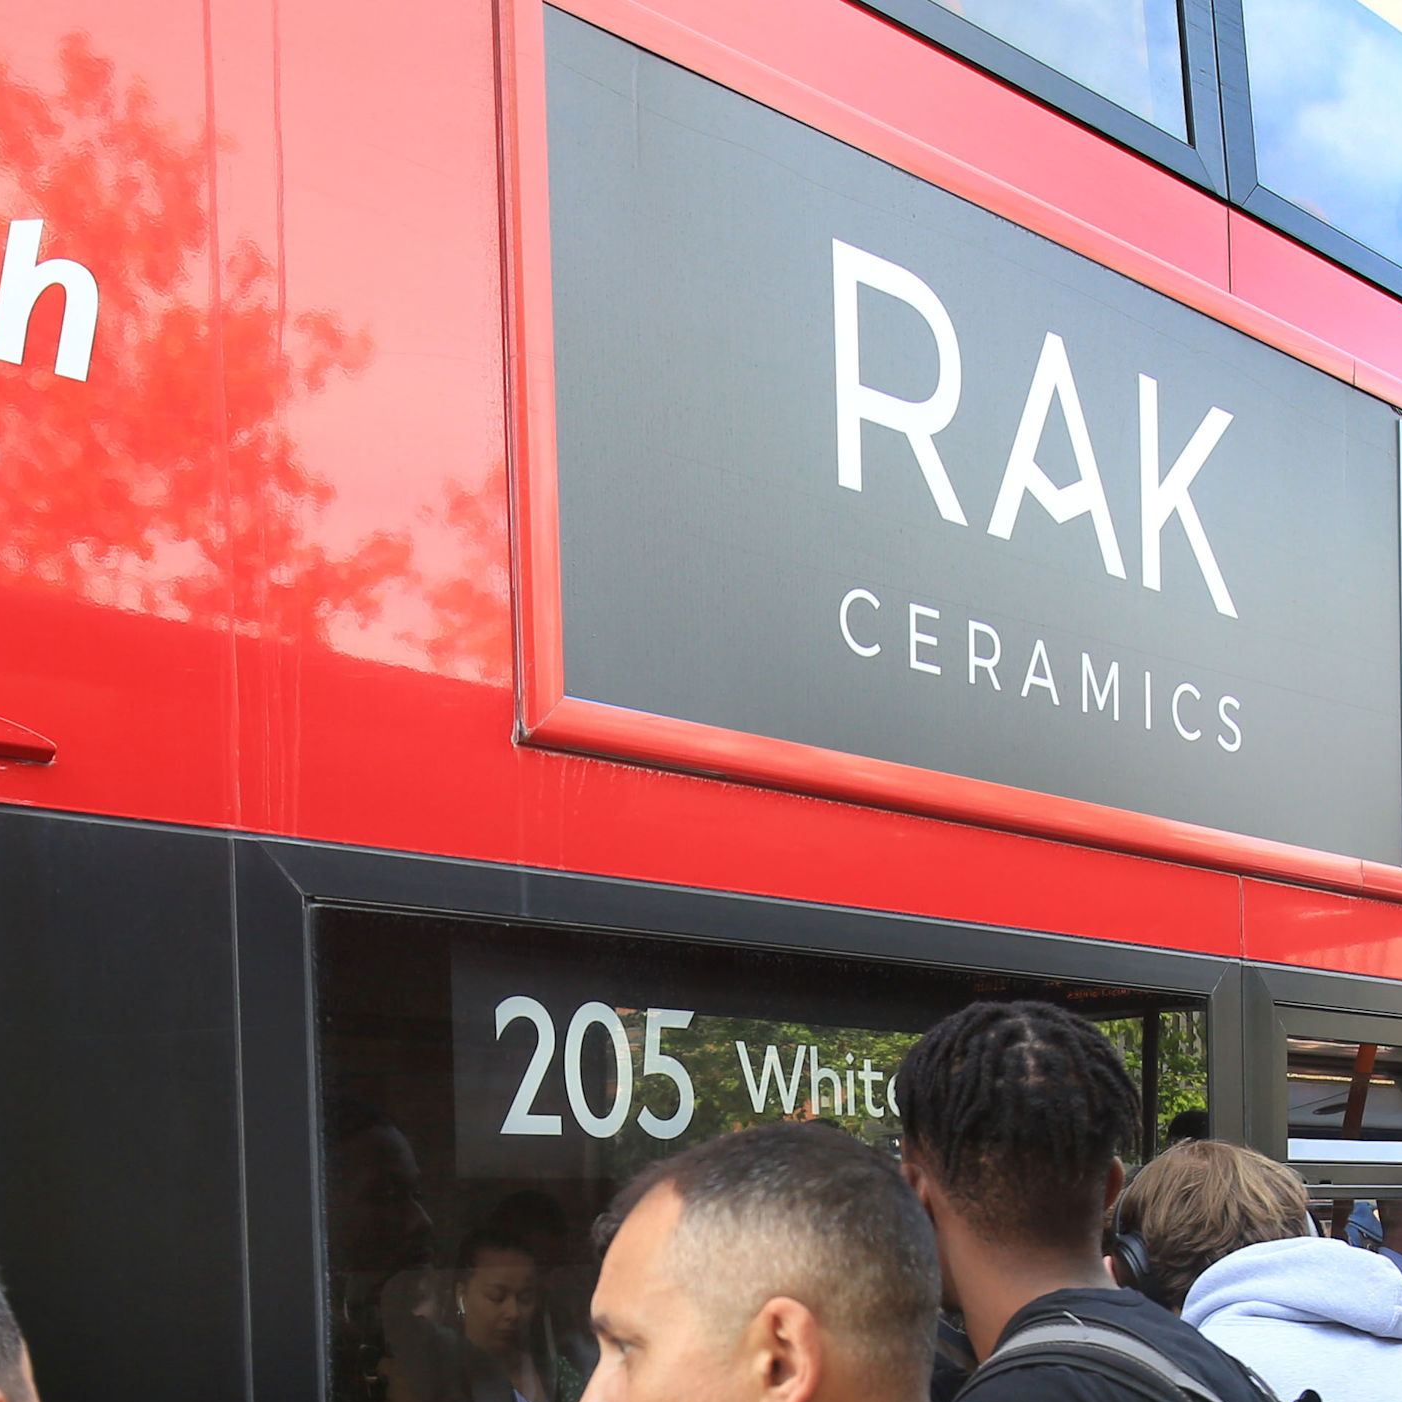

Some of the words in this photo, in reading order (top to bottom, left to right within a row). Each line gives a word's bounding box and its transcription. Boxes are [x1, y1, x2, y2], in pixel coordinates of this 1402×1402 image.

[831, 237, 1239, 620] RAK
[838, 588, 1244, 753] CERAMICS
[493, 995, 696, 1140] 205
